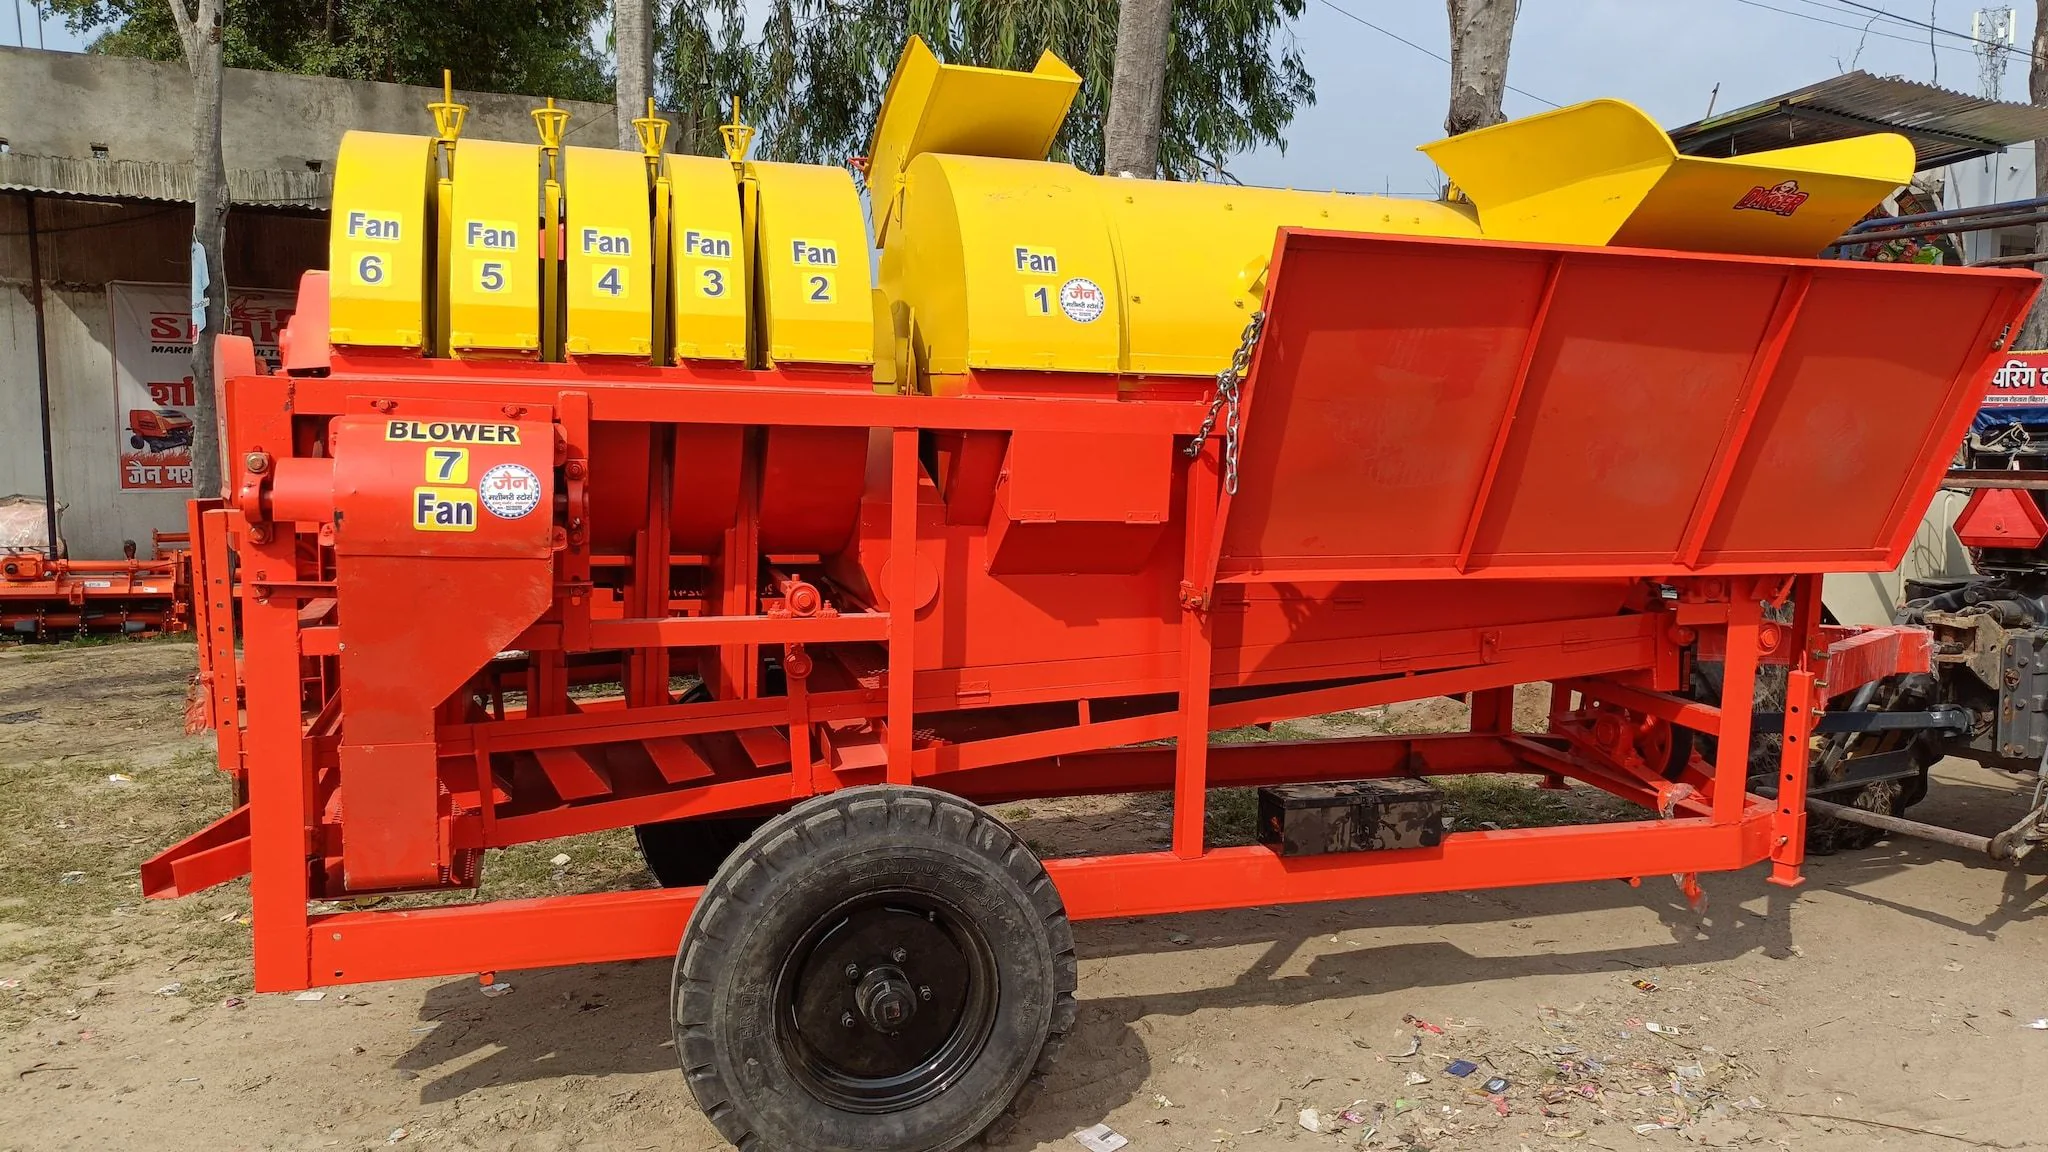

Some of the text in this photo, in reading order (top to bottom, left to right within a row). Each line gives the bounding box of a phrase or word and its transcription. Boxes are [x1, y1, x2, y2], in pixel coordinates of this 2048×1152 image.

[1733, 185, 1809, 216] DANGER
[348, 212, 400, 240] Fan
[468, 222, 516, 248] Fan
[583, 229, 630, 255] Fan
[685, 232, 731, 258] Fan
[793, 241, 837, 267] Fan
[359, 256, 384, 283] 6
[1016, 248, 1057, 272] Fan
[481, 263, 505, 290] 5
[597, 268, 621, 296] 4
[703, 270, 725, 297] 3
[810, 276, 830, 301] 2
[1034, 287, 1049, 313] 1
[1068, 283, 1096, 300] जैन
[389, 421, 516, 442] BLOWER
[126, 461, 162, 484] जैन
[434, 451, 461, 480] 7
[492, 470, 529, 490] जैन
[418, 493, 473, 525] Fan
